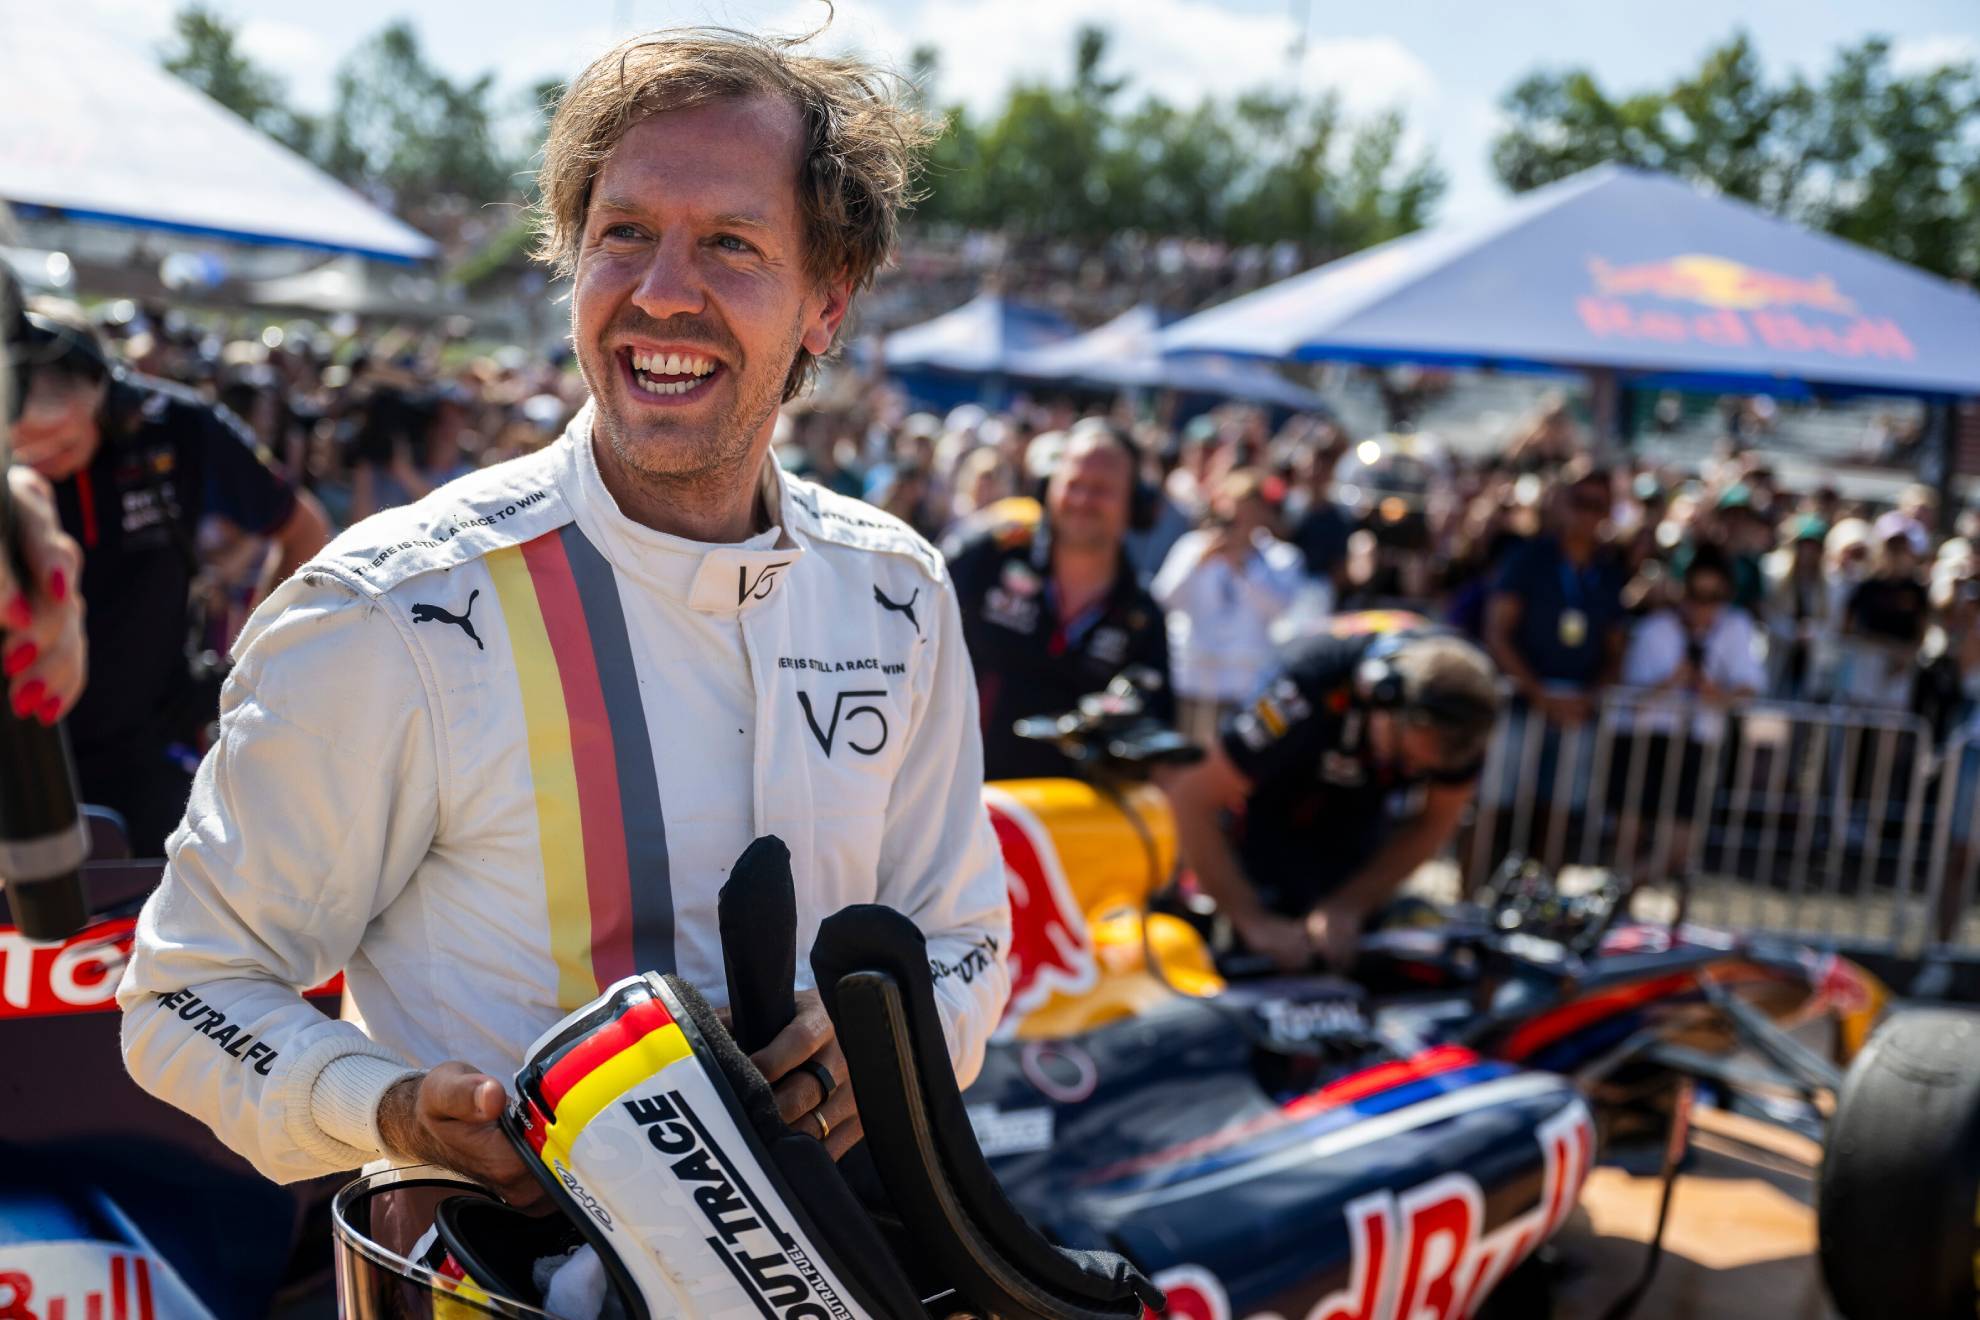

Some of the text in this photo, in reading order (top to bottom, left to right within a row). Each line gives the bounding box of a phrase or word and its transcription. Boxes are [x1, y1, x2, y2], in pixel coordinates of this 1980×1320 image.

[353, 546, 398, 577] THERE
[398, 540, 413, 551] IS
[449, 527, 461, 537] A
[459, 515, 497, 530] RACE
[495, 505, 517, 521] TO
[517, 490, 547, 509] WIN
[795, 658, 807, 669] IS
[808, 658, 832, 673] STILL
[835, 662, 845, 672] A
[846, 658, 879, 671] RACE
[881, 663, 906, 675] WIN
[623, 1093, 762, 1245] TRACE
[786, 1244, 855, 1320] EUTRAL FUEL
